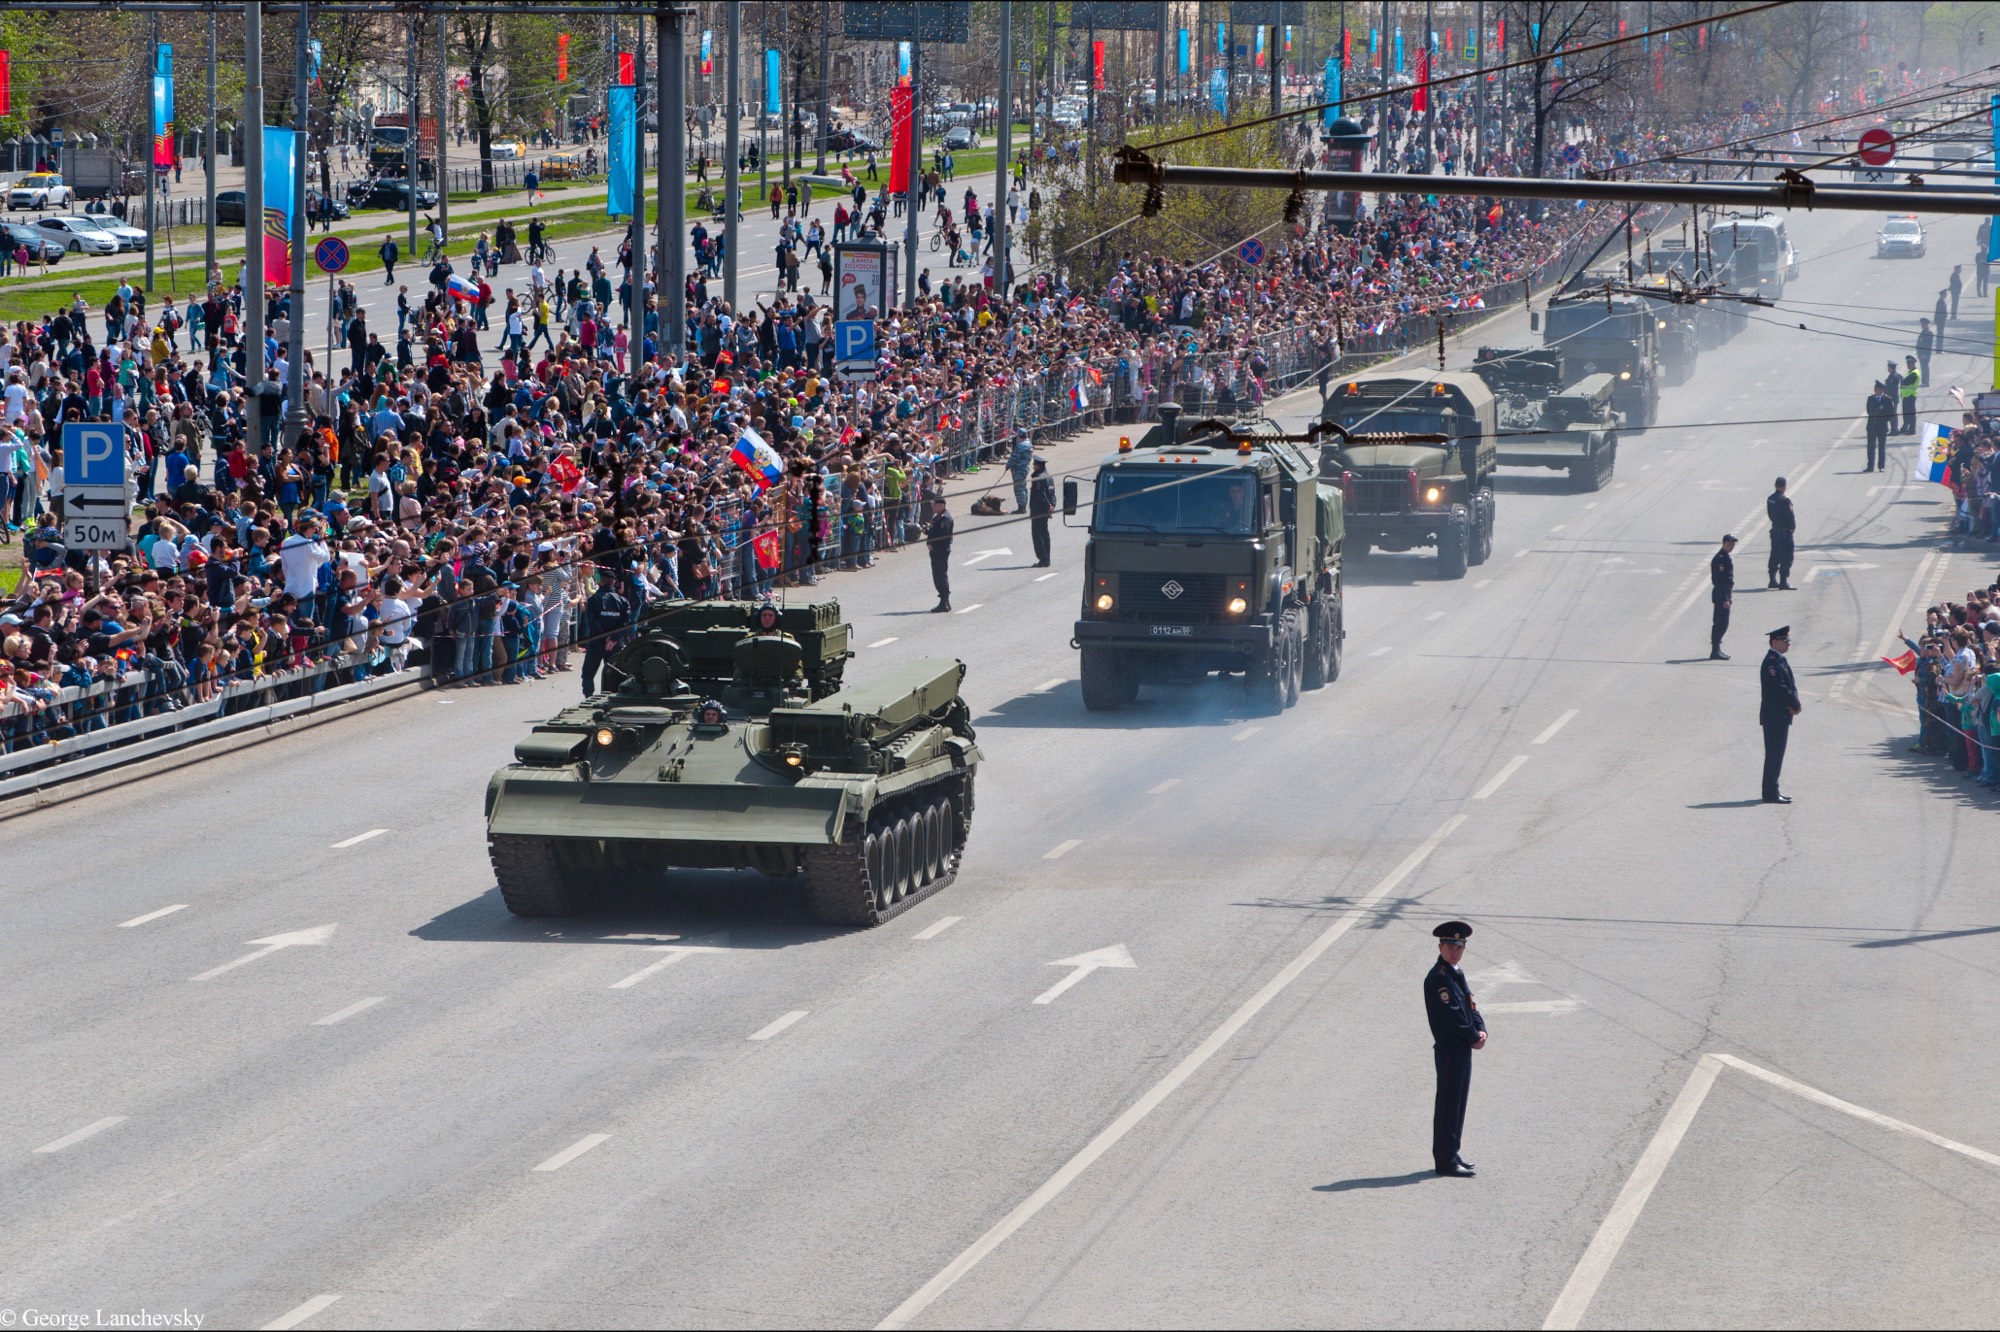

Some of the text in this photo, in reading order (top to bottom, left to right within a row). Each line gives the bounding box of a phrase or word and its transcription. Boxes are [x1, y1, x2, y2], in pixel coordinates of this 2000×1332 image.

[872, 274, 880, 282] 20
[846, 325, 867, 356] P
[81, 430, 113, 479] P
